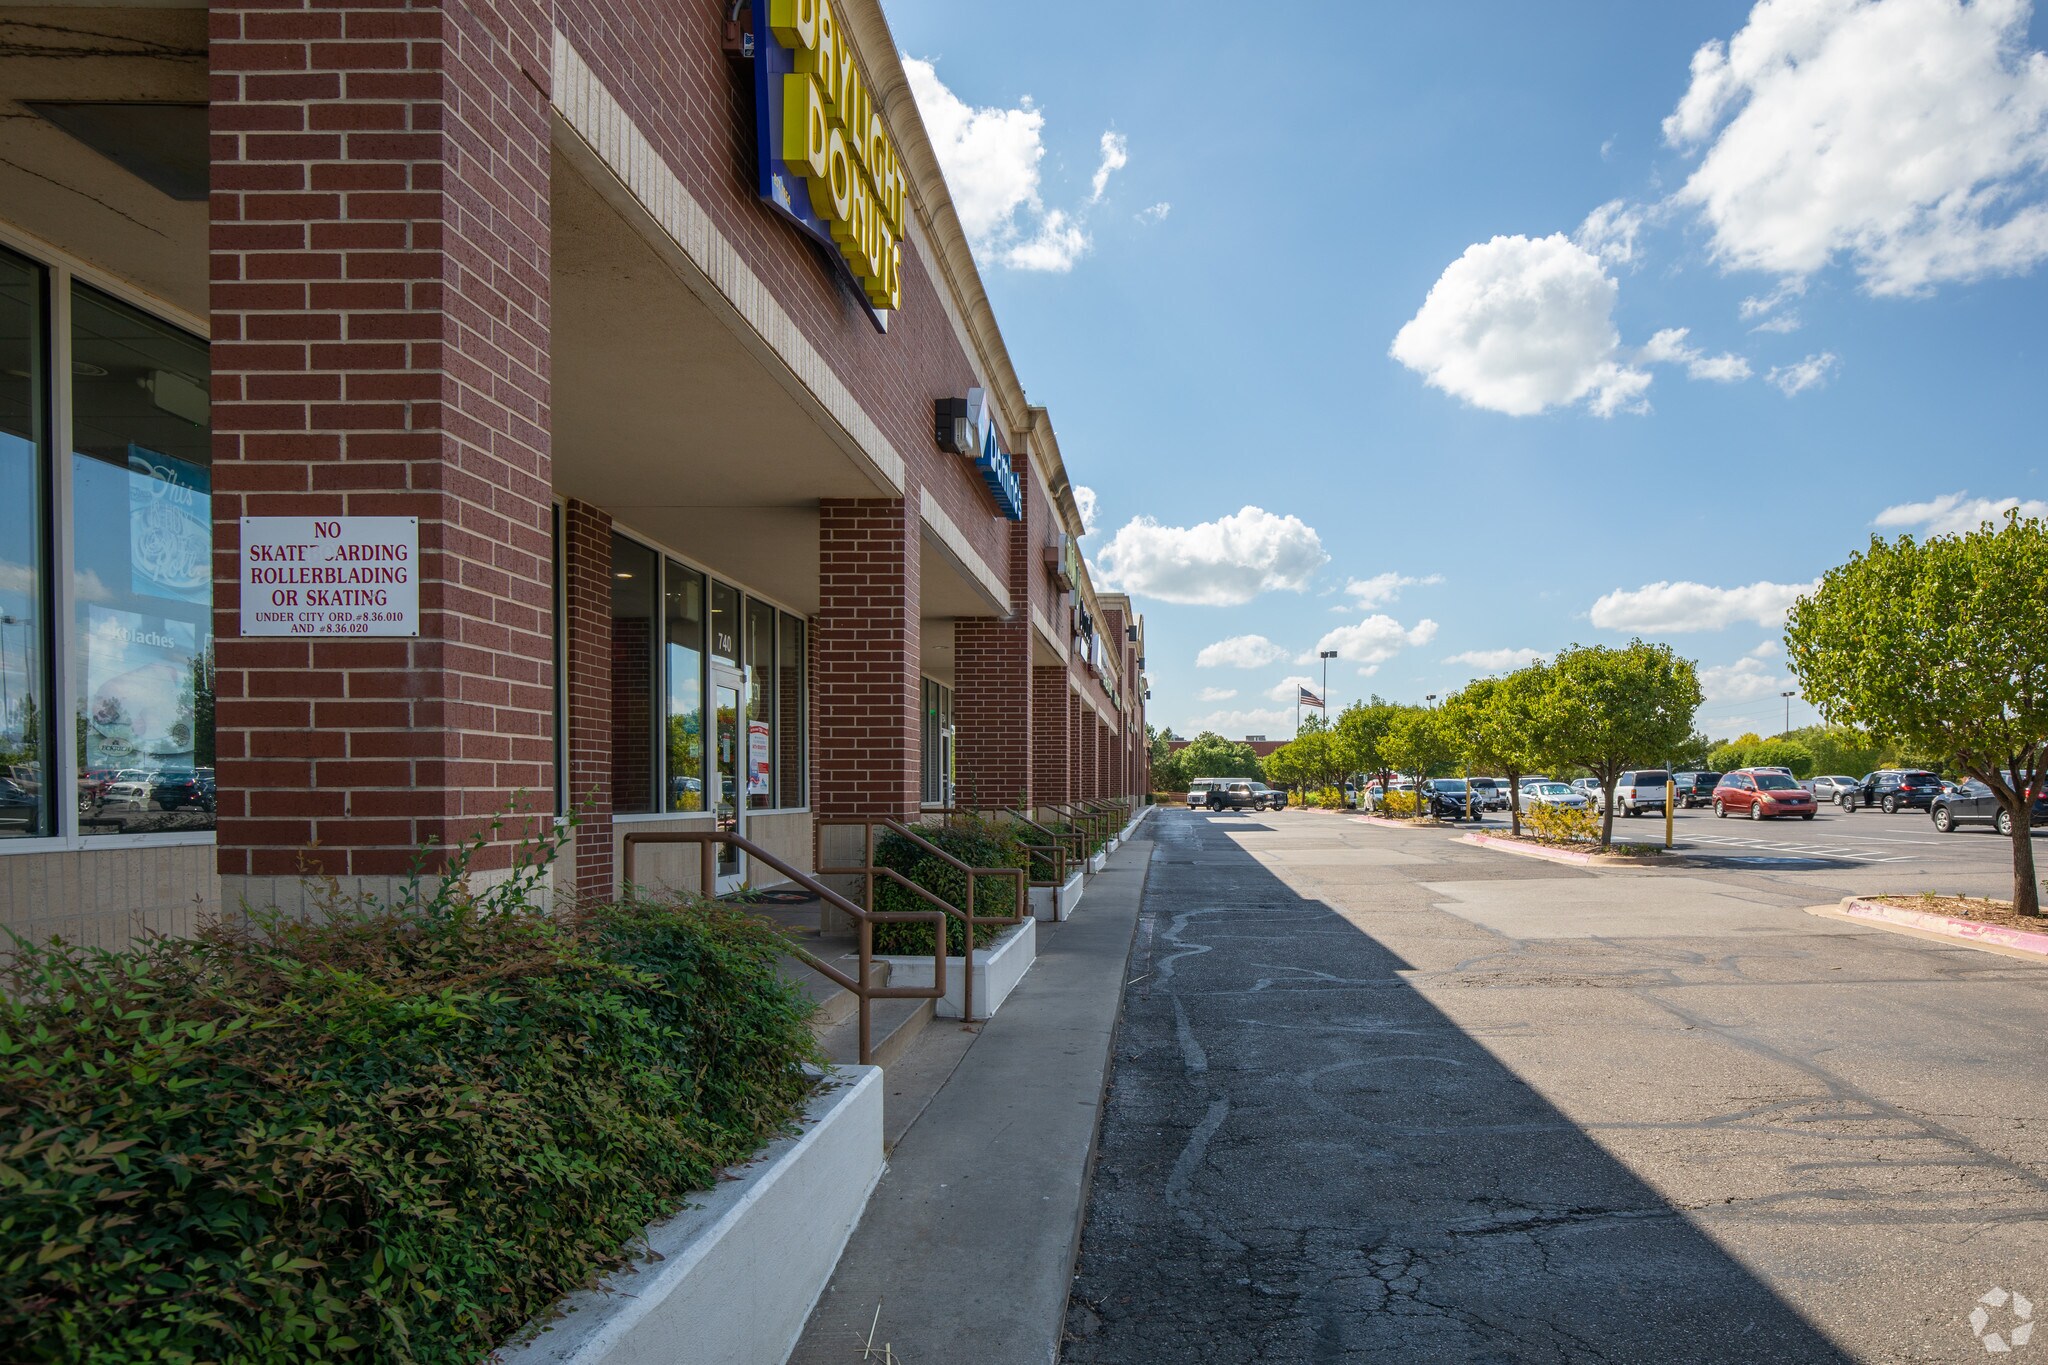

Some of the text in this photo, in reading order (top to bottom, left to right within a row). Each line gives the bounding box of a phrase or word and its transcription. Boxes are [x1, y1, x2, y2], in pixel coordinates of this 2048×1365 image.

[806, 72, 901, 311] DONUTS
[150, 465, 193, 506] This
[314, 521, 342, 539] NO
[250, 544, 408, 562] SKATEARDING
[250, 567, 408, 585] ROLLERBLADING
[271, 589, 388, 607] OR SKATING
[255, 612, 295, 622] UNDER
[298, 612, 325, 622] CITY
[290, 623, 369, 633] AND #8.36.020
[718, 633, 732, 652] 740
